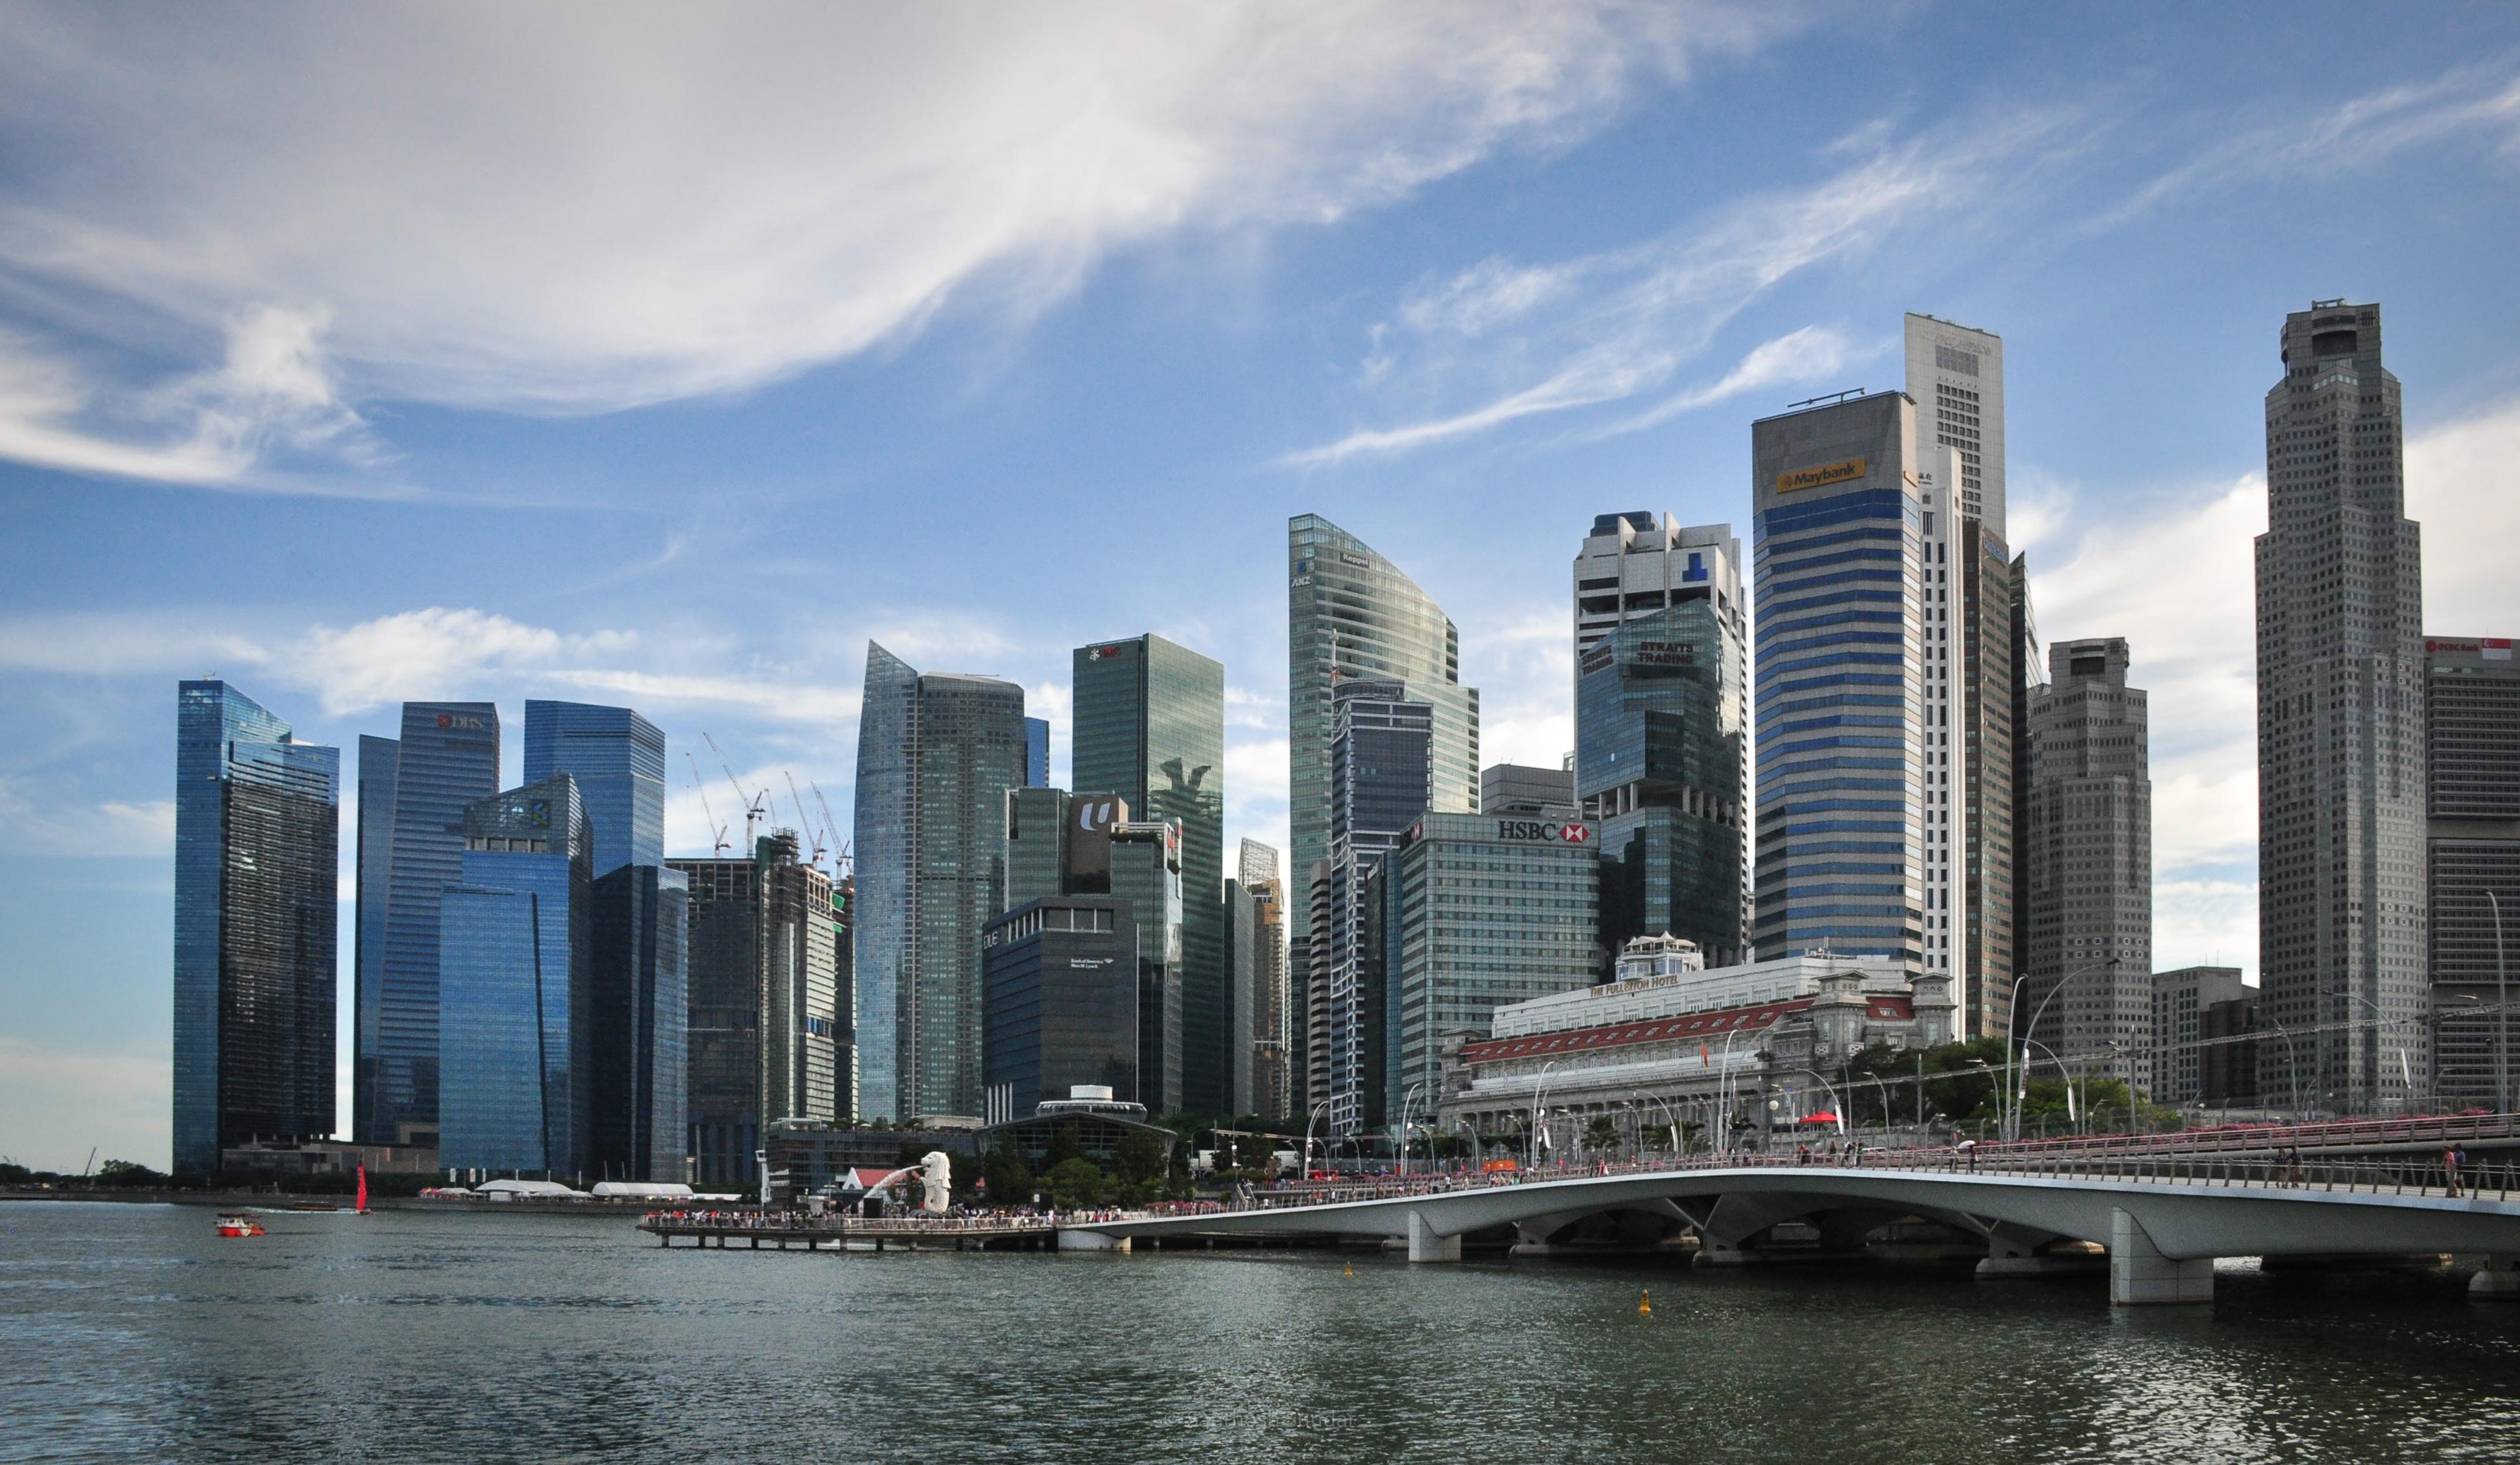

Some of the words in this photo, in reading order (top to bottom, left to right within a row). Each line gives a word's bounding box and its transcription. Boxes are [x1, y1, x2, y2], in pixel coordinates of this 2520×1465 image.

[1795, 463, 1855, 484] Maybank
[1343, 553, 1368, 565] Keppel
[1292, 576, 1311, 587] ANZ
[1640, 641, 1693, 652] STRAITS
[1638, 653, 1693, 664] TRADING
[1499, 821, 1557, 840] HSBC
[1590, 987, 1603, 997] THE
[1652, 975, 1679, 988] HOTEL
